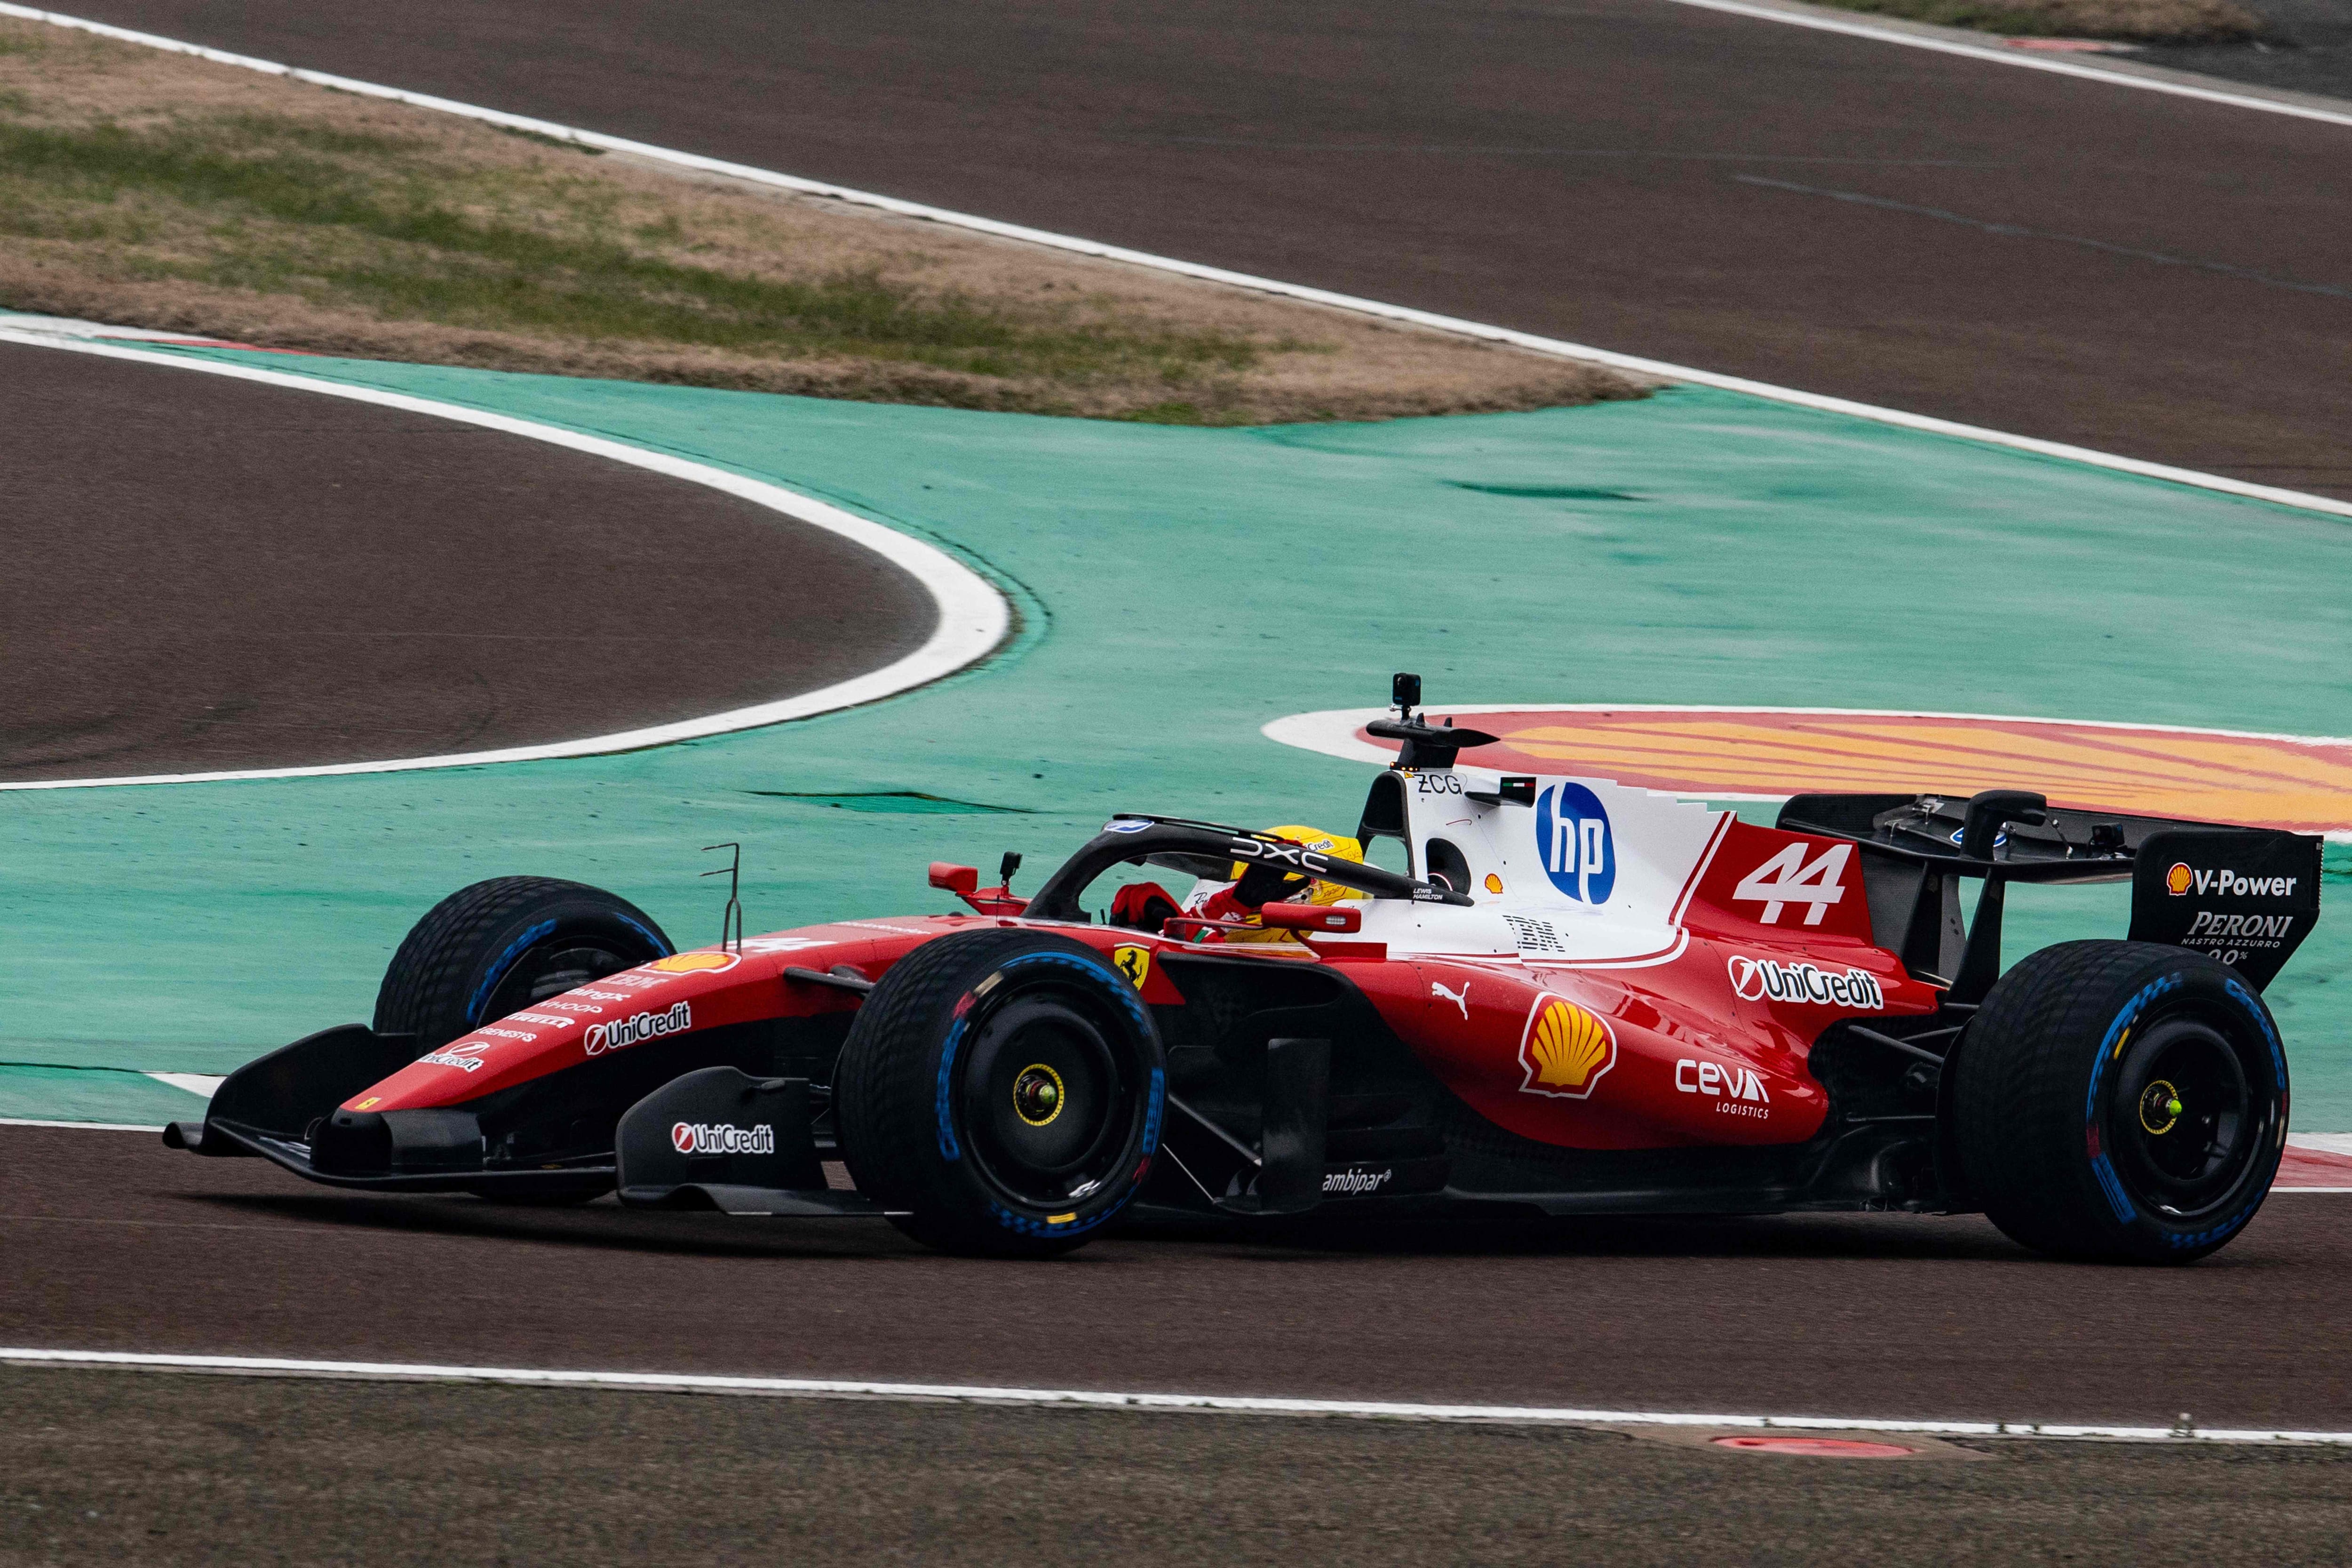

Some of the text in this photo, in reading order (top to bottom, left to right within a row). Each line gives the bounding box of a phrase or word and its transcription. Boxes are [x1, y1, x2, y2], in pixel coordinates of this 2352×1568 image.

[1414, 774, 1462, 795] ZCG
[1230, 836, 1328, 873] DXC
[1305, 839, 1334, 852] Credit
[1550, 782, 1604, 904] hp
[1732, 843, 1853, 925] 44
[2194, 869, 2296, 896] V-Power
[1502, 915, 1565, 952] IBM
[2187, 911, 2294, 938] PERONI
[2226, 939, 2280, 948] AZZURRO
[597, 973, 670, 988] IBM
[1760, 963, 1881, 1006] UniCredit
[502, 1012, 575, 1029] PIRELLI
[608, 1003, 689, 1047] UniCredit
[479, 1027, 537, 1042] GENESYS
[1716, 1102, 1769, 1119] LOGISTICS
[694, 1126, 771, 1151] UniCredit
[1322, 1168, 1384, 1195] ambipar
